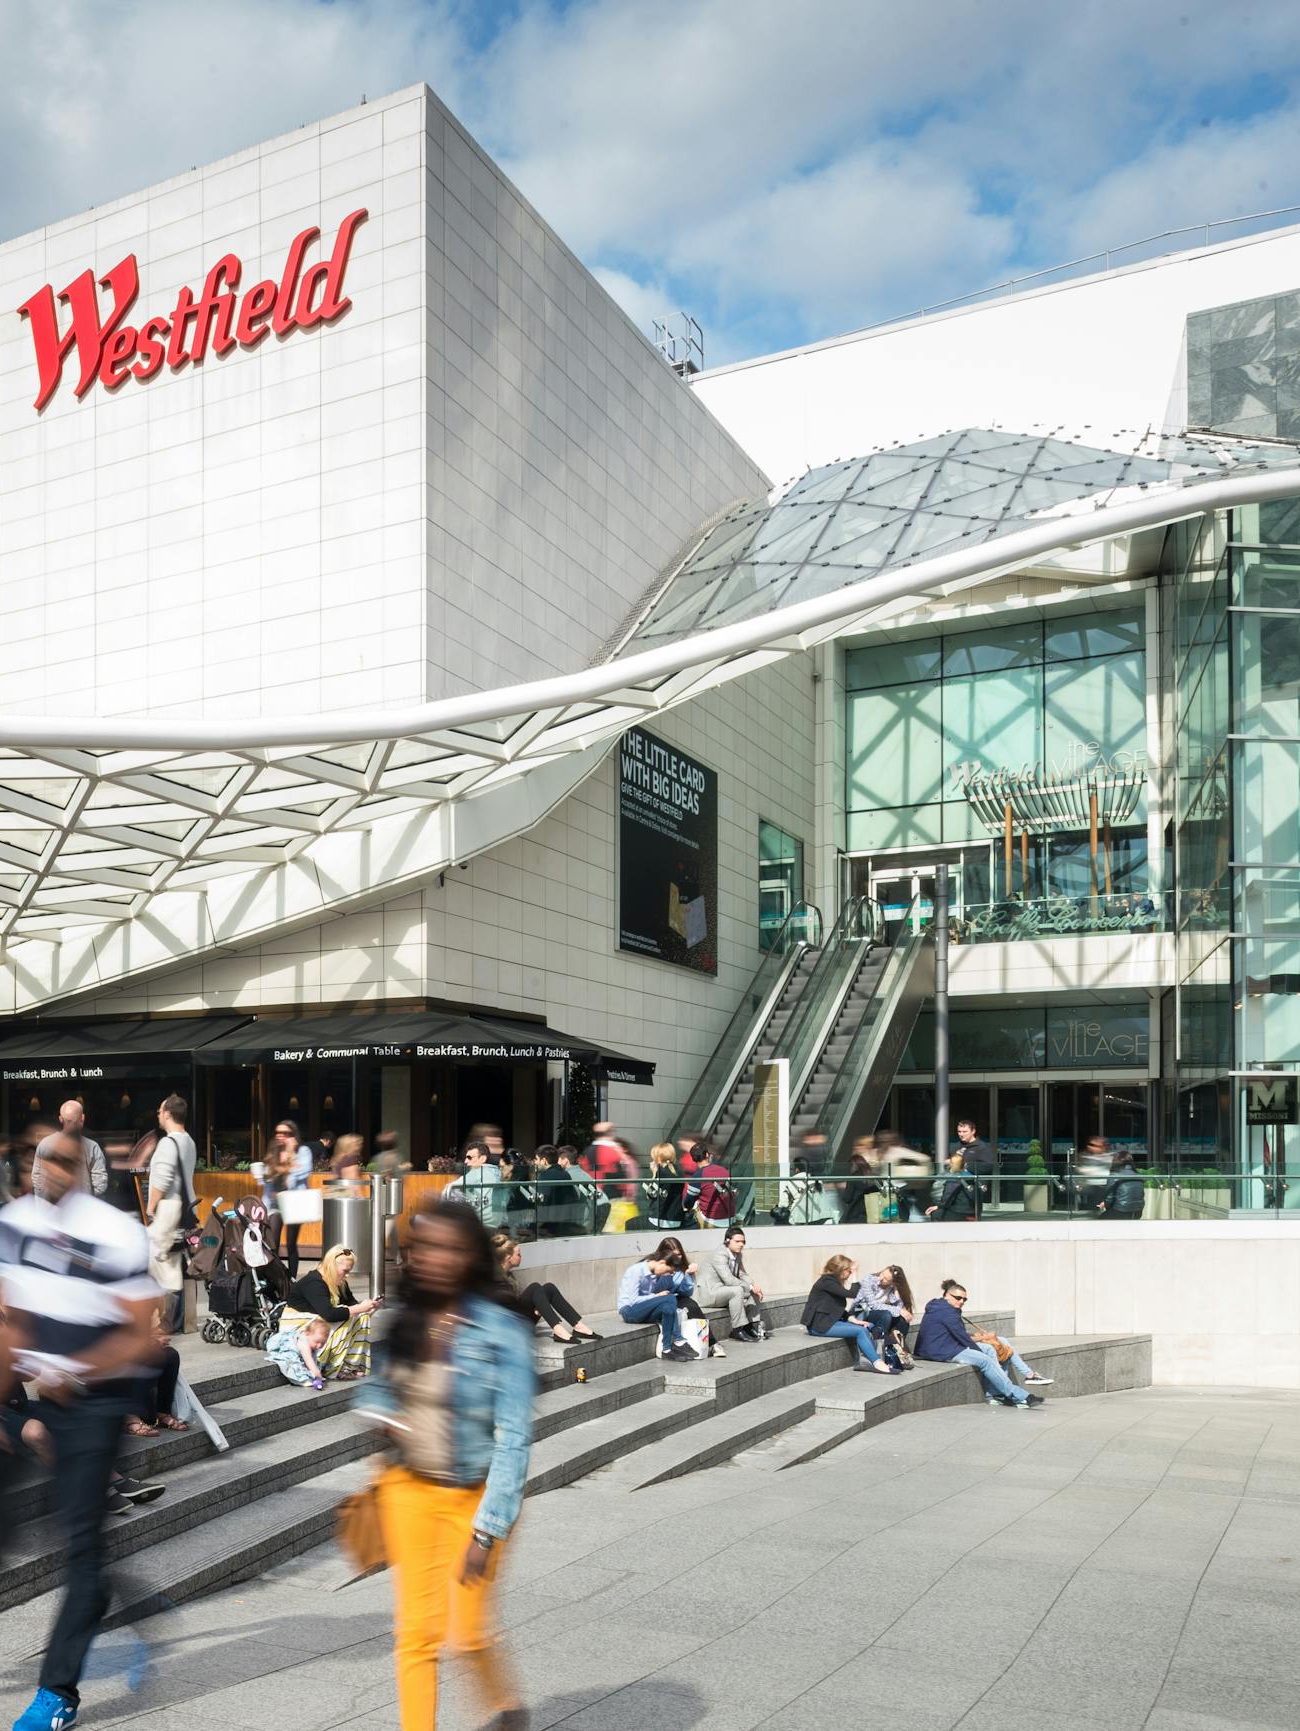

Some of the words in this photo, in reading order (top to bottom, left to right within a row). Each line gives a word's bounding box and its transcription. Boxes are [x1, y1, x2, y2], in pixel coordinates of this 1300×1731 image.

[16, 208, 369, 411] Westfield
[622, 729, 643, 759] THE
[645, 740, 677, 778] LITTLE
[680, 761, 705, 793] CARD
[1068, 740, 1100, 756] the
[1052, 749, 1147, 779] VILLAGE
[621, 753, 650, 790] WITH
[653, 770, 670, 799] BIG
[672, 781, 699, 815] IDEAS
[633, 787, 642, 801] THE
[653, 798, 659, 808] OF
[659, 801, 683, 821] WESTFIELD
[1069, 1021, 1101, 1037] the
[274, 1050, 304, 1062] Bakery
[306, 1049, 313, 1059] &
[316, 1047, 369, 1059] Communal
[373, 1046, 400, 1056] Table
[416, 1045, 470, 1057] Breakfast,
[472, 1045, 509, 1058] Brunch,
[510, 1046, 534, 1057] Lunch
[536, 1047, 543, 1057] &
[544, 1047, 570, 1059] Pastries
[1053, 1034, 1149, 1058] VILLAGE
[3, 1069, 40, 1080] Breakfast,
[41, 1068, 68, 1079] Brunch
[70, 1068, 77, 1077] &
[80, 1067, 103, 1077] Lunch
[1249, 1080, 1288, 1111] M
